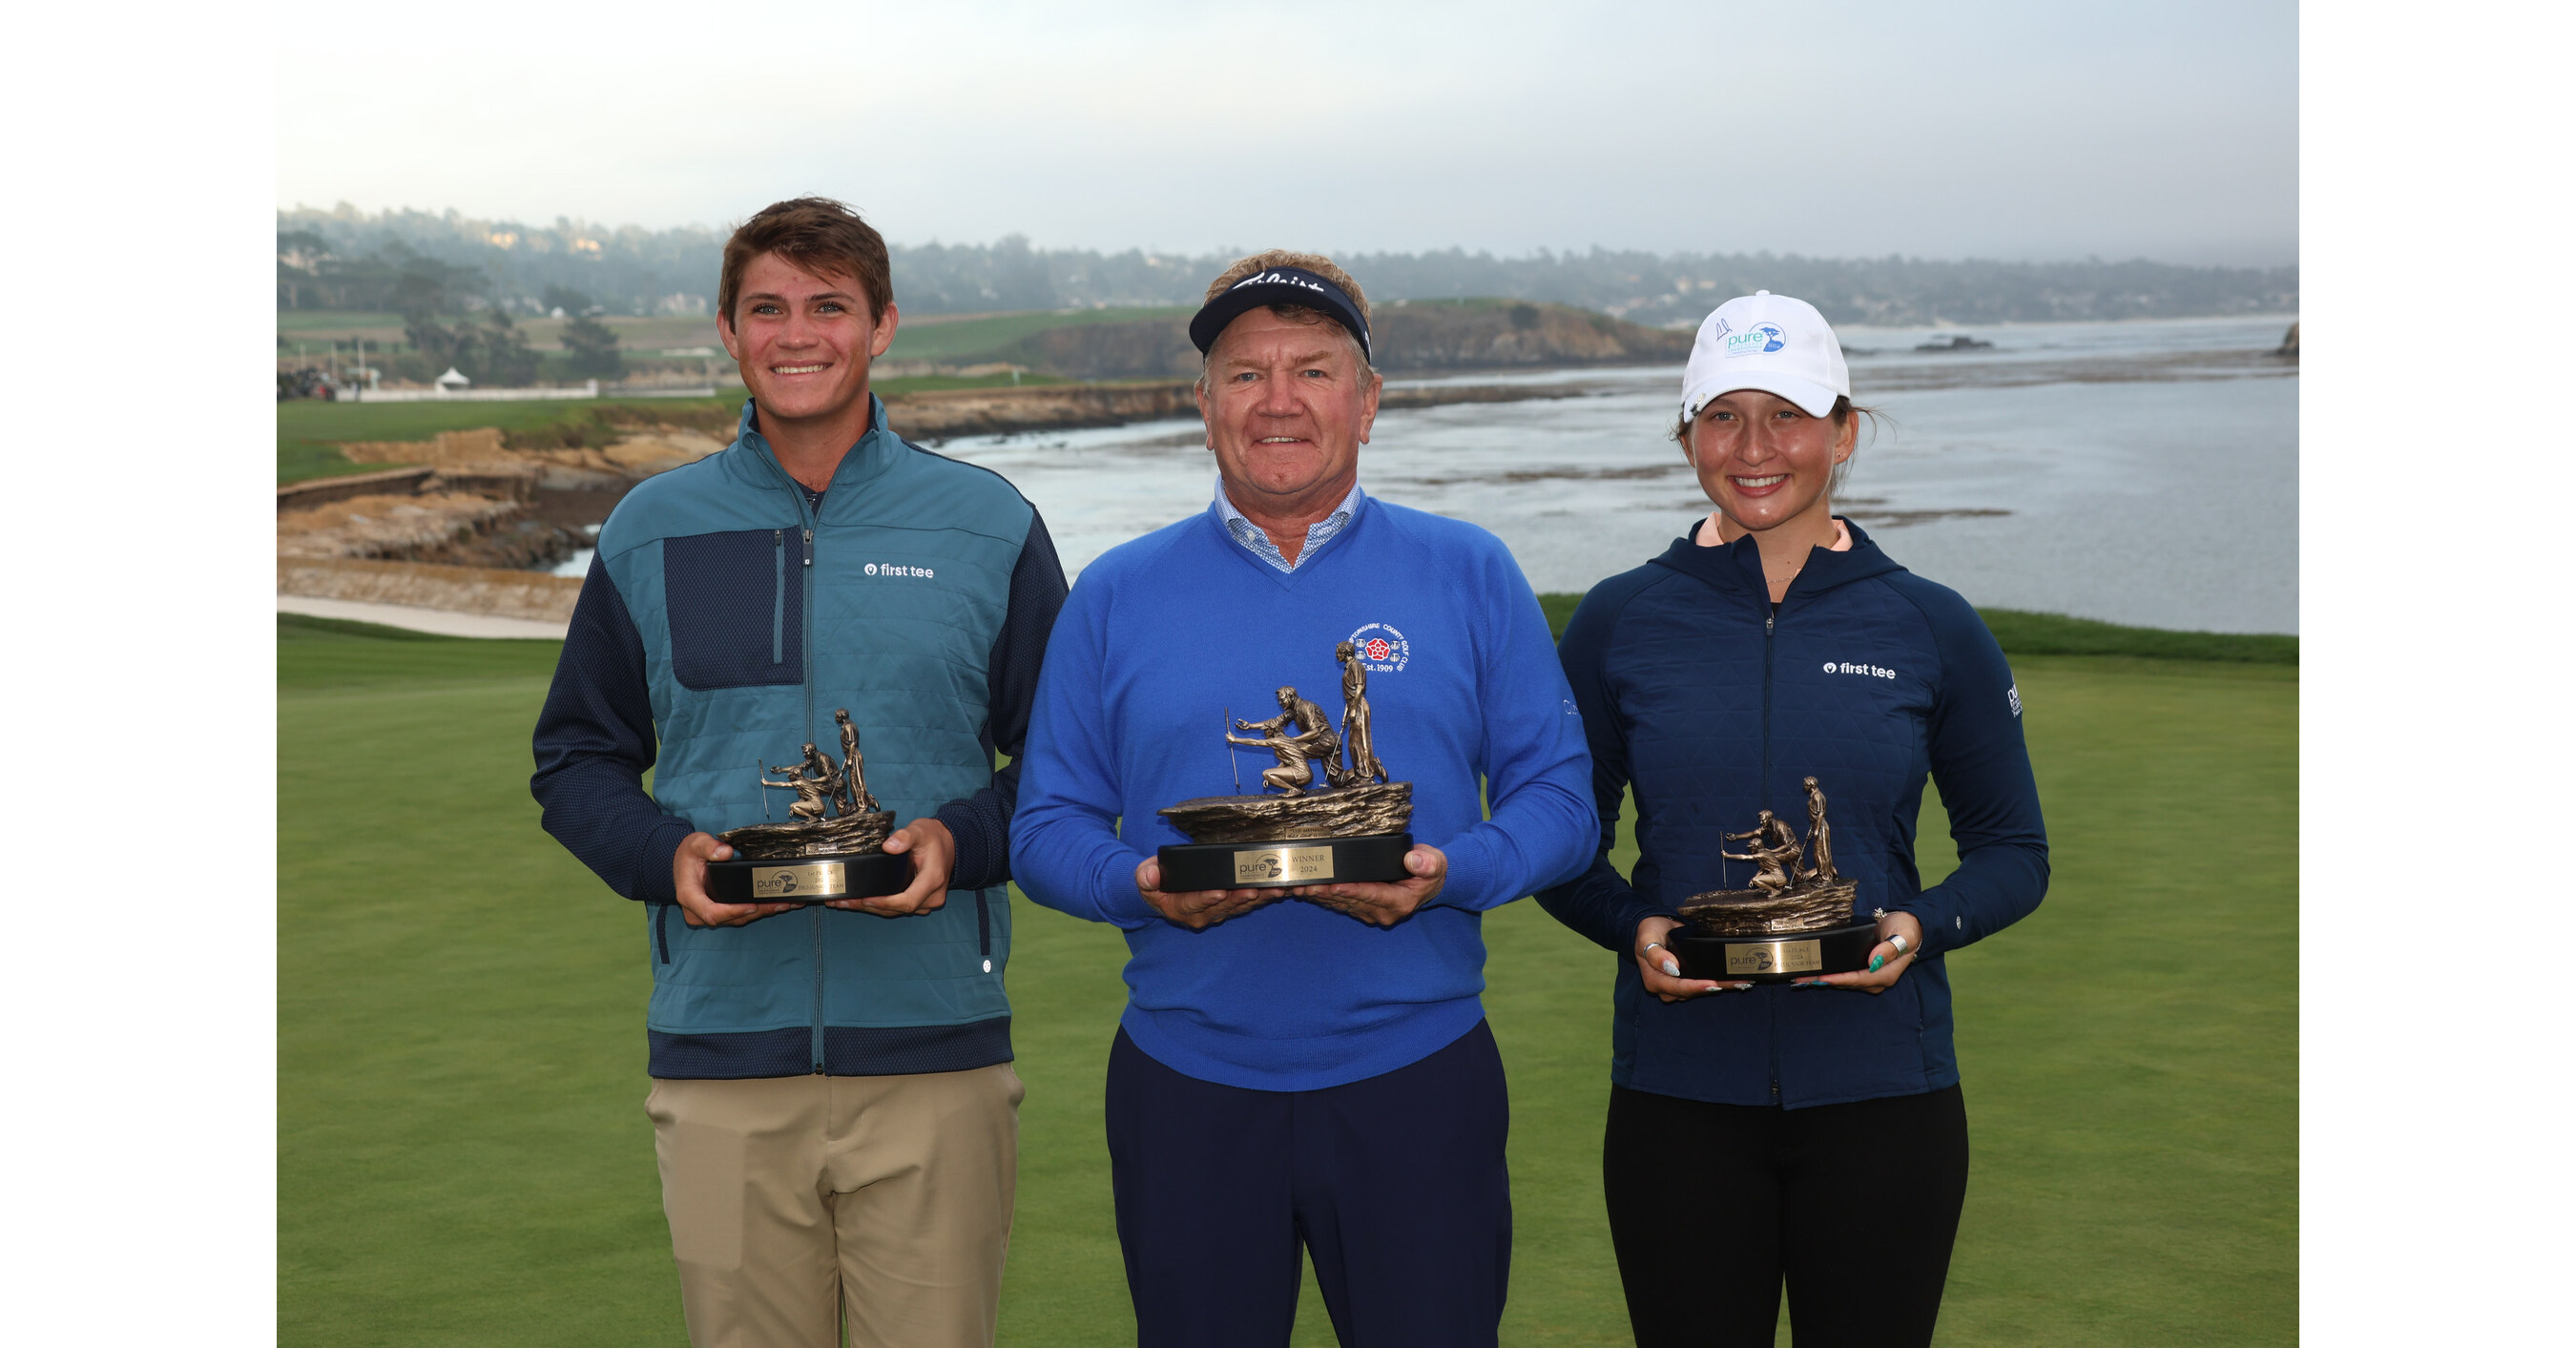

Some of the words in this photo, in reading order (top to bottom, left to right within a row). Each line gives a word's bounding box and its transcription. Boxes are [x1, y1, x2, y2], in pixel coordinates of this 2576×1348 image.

[1728, 332, 1763, 349] pure
[881, 563, 908, 576] first
[909, 566, 934, 578] tee
[1382, 623, 1404, 640] COUNTY
[1401, 640, 1409, 656] GOLF
[1396, 656, 1408, 672] CLUB
[1839, 662, 1869, 675] first
[1871, 665, 1896, 679] tee
[1239, 863, 1267, 875] pure
[758, 880, 782, 890] pure
[1730, 956, 1756, 967] pure
